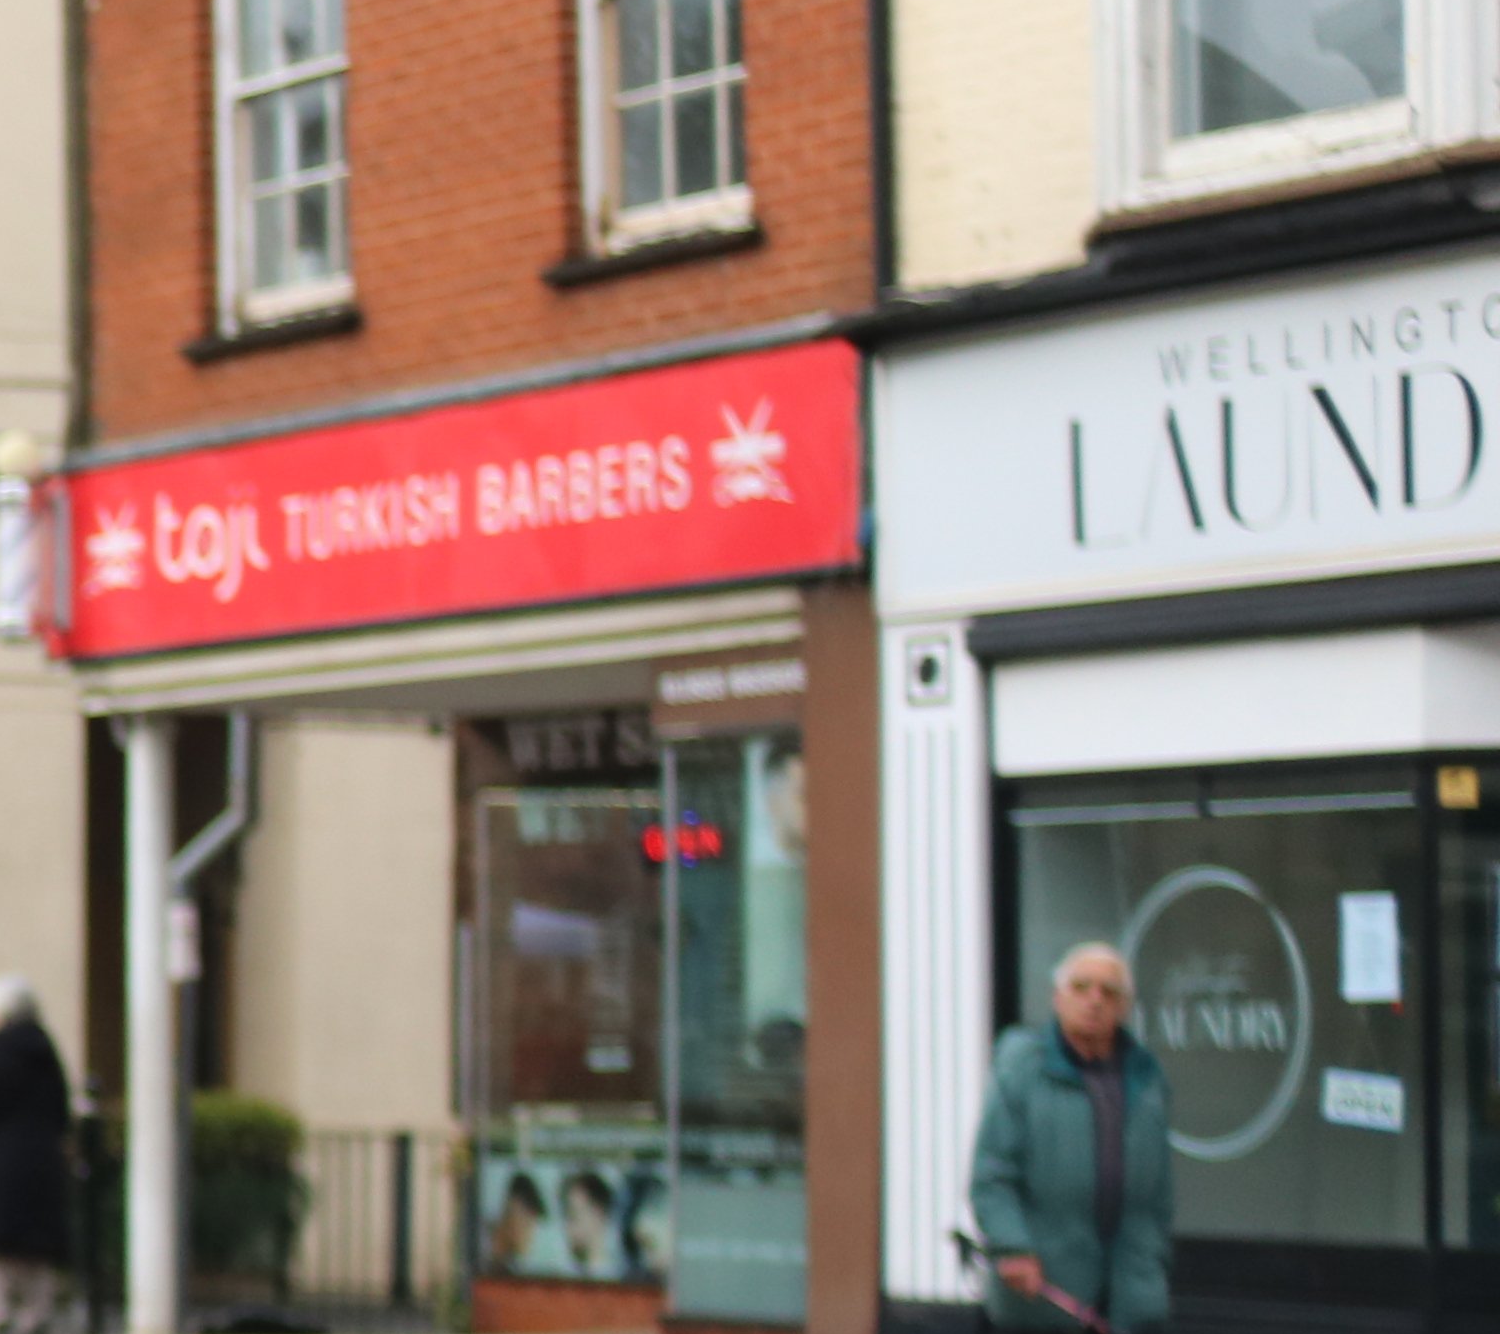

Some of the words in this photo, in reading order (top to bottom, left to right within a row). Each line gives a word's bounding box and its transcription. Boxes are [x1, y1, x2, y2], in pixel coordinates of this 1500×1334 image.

[280, 471, 462, 562] TURKISH
[475, 434, 694, 536] BARBERS
[1069, 360, 1485, 549] LAUND
